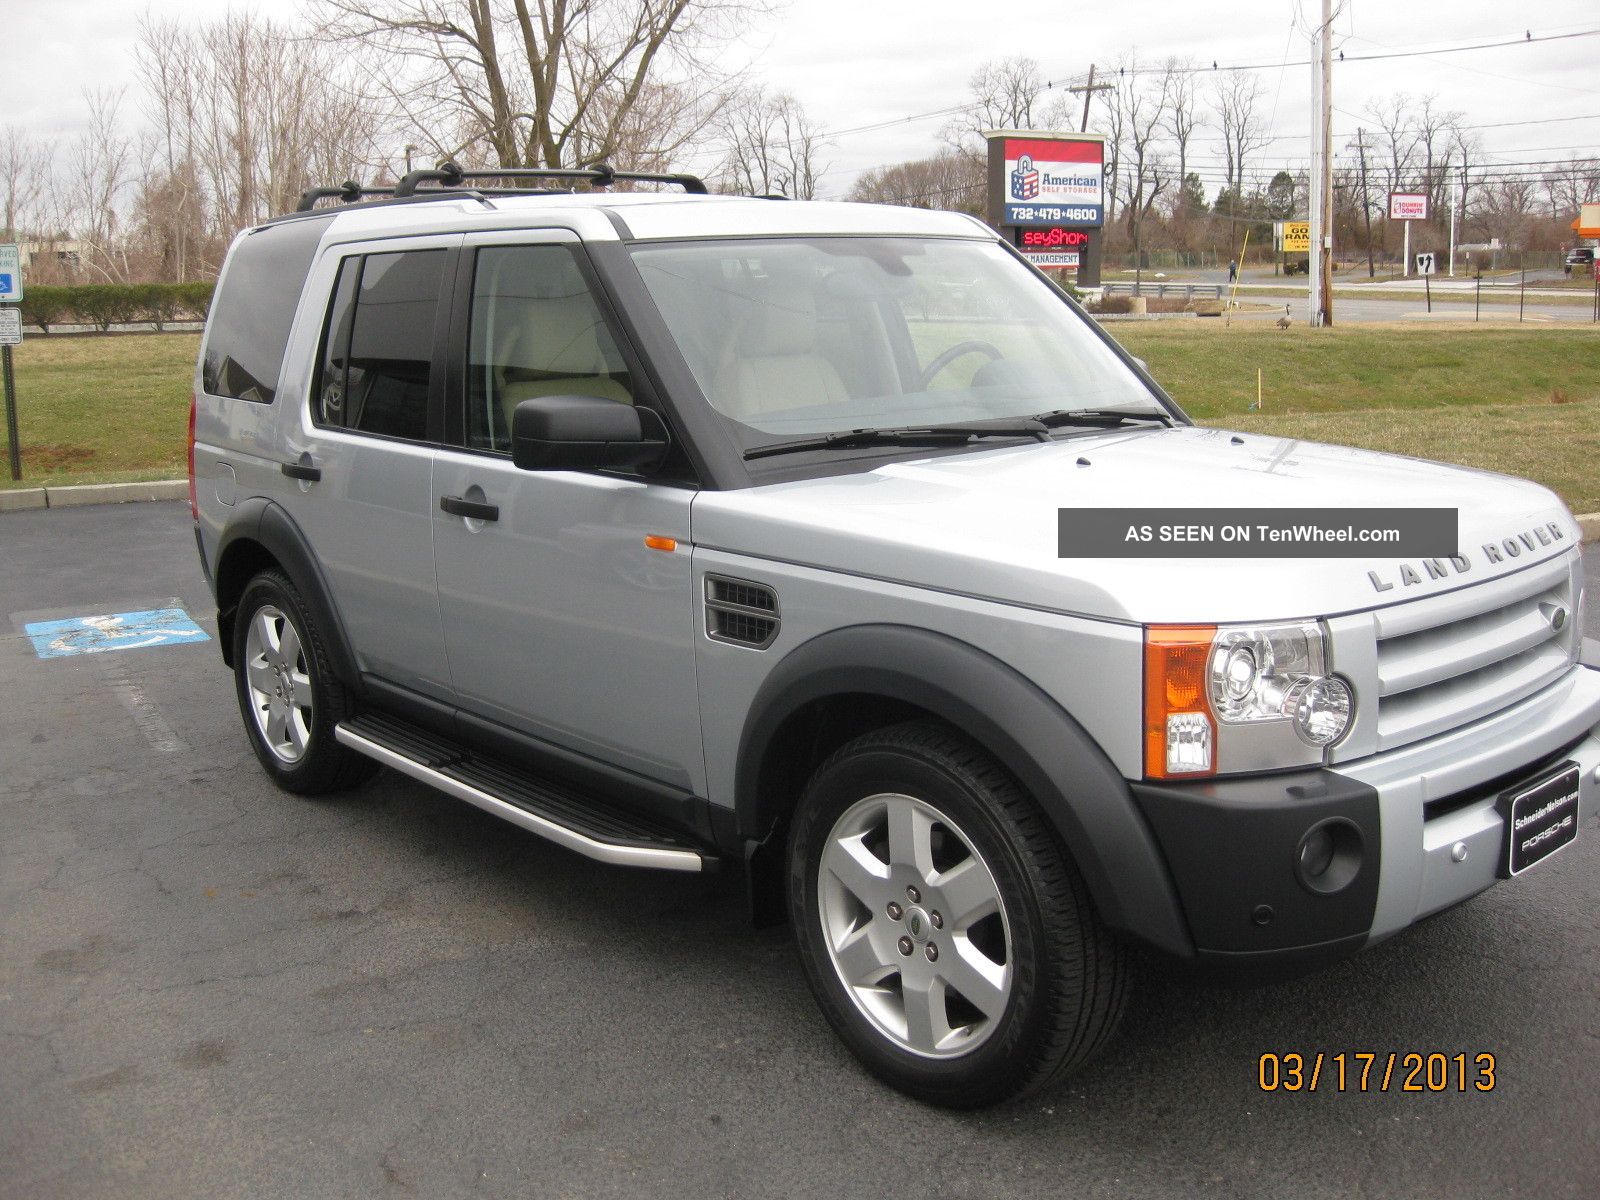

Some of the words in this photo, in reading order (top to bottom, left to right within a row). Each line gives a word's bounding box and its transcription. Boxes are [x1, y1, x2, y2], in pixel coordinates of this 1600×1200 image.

[1042, 173, 1097, 187] American
[1030, 254, 1078, 263] MANAGEMENT
[1367, 551, 1472, 592] LAND
[1481, 521, 1564, 564] ROVER
[1521, 815, 1572, 851] PORSCHE
